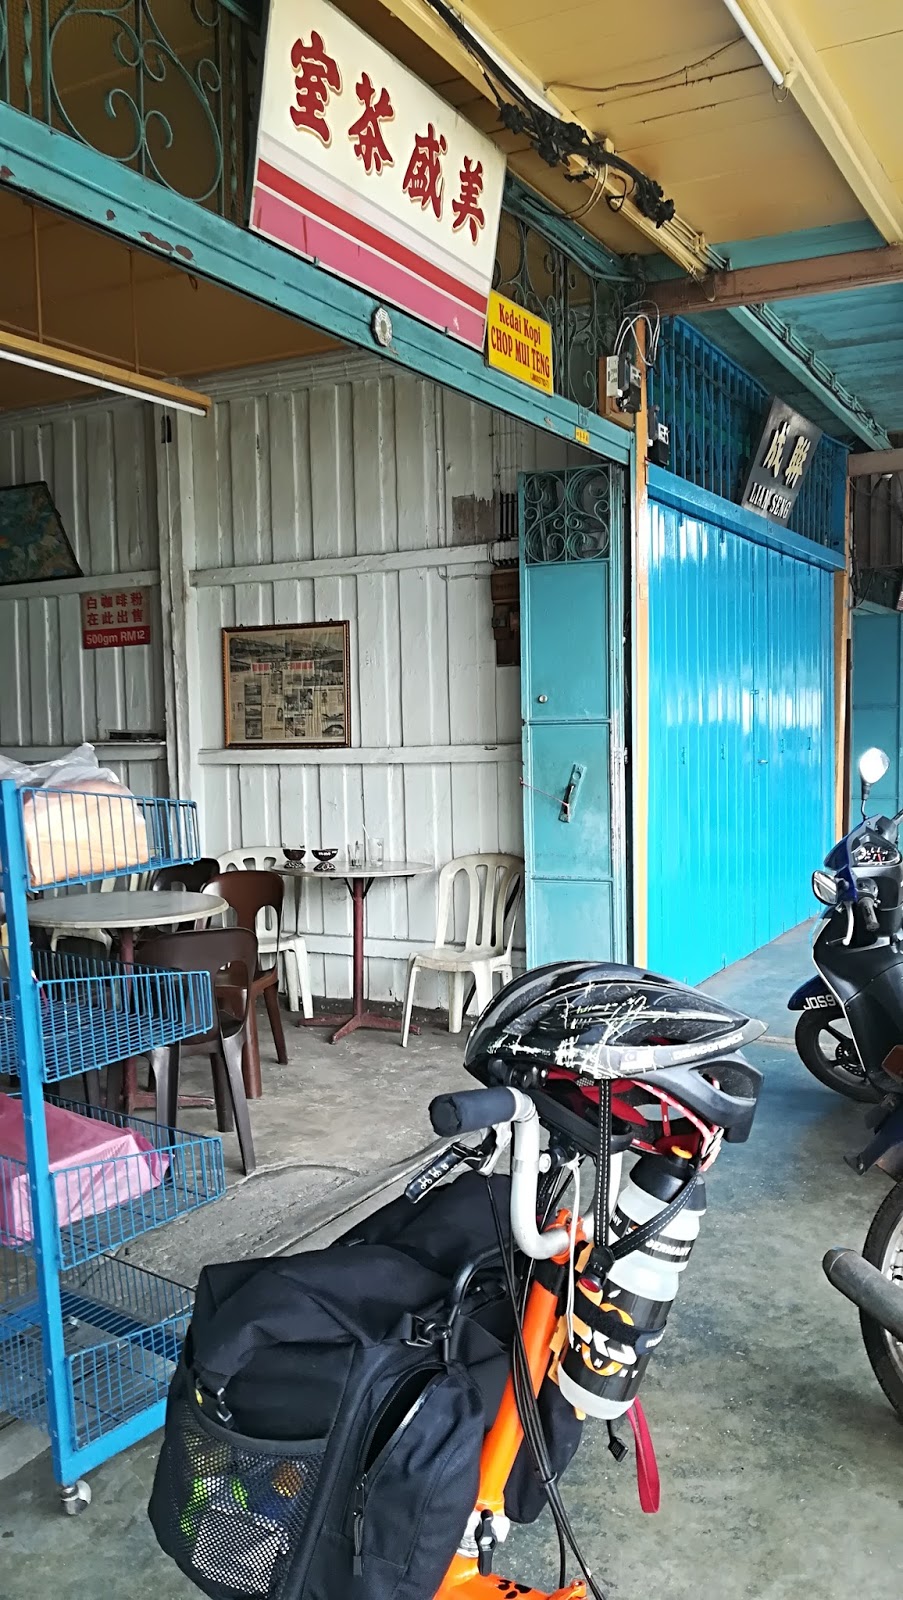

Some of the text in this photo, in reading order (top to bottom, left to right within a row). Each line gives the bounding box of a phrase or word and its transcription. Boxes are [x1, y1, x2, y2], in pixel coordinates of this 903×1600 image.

[499, 303, 541, 347] Kedai Kopi
[491, 326, 550, 378] CHOP MUI TENG
[749, 482, 792, 519] LIAN SENG
[87, 608, 144, 626] 在此出售
[86, 634, 118, 645] 500gm
